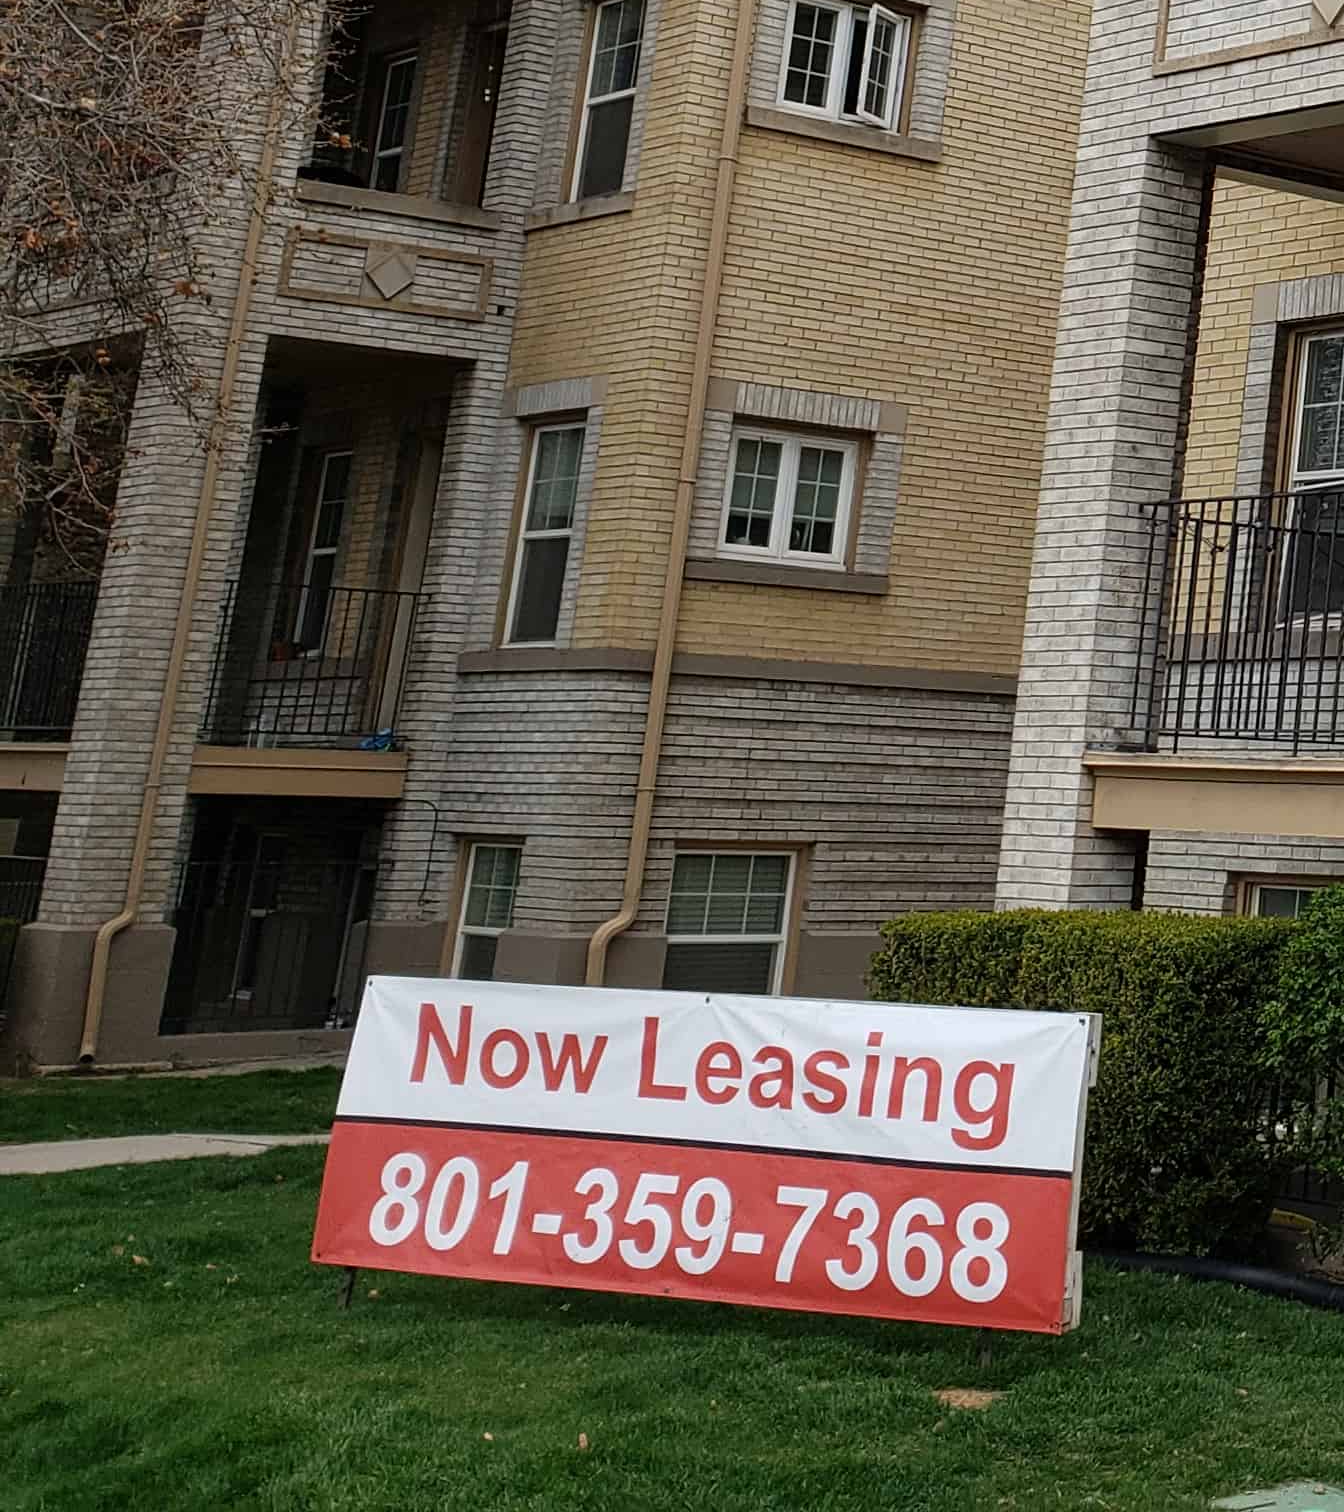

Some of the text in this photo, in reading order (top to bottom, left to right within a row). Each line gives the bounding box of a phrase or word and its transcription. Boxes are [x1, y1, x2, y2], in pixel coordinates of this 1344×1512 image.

[410, 1002, 1016, 1151] Now Leasing
[368, 1151, 1011, 1303] 801-359-7368
